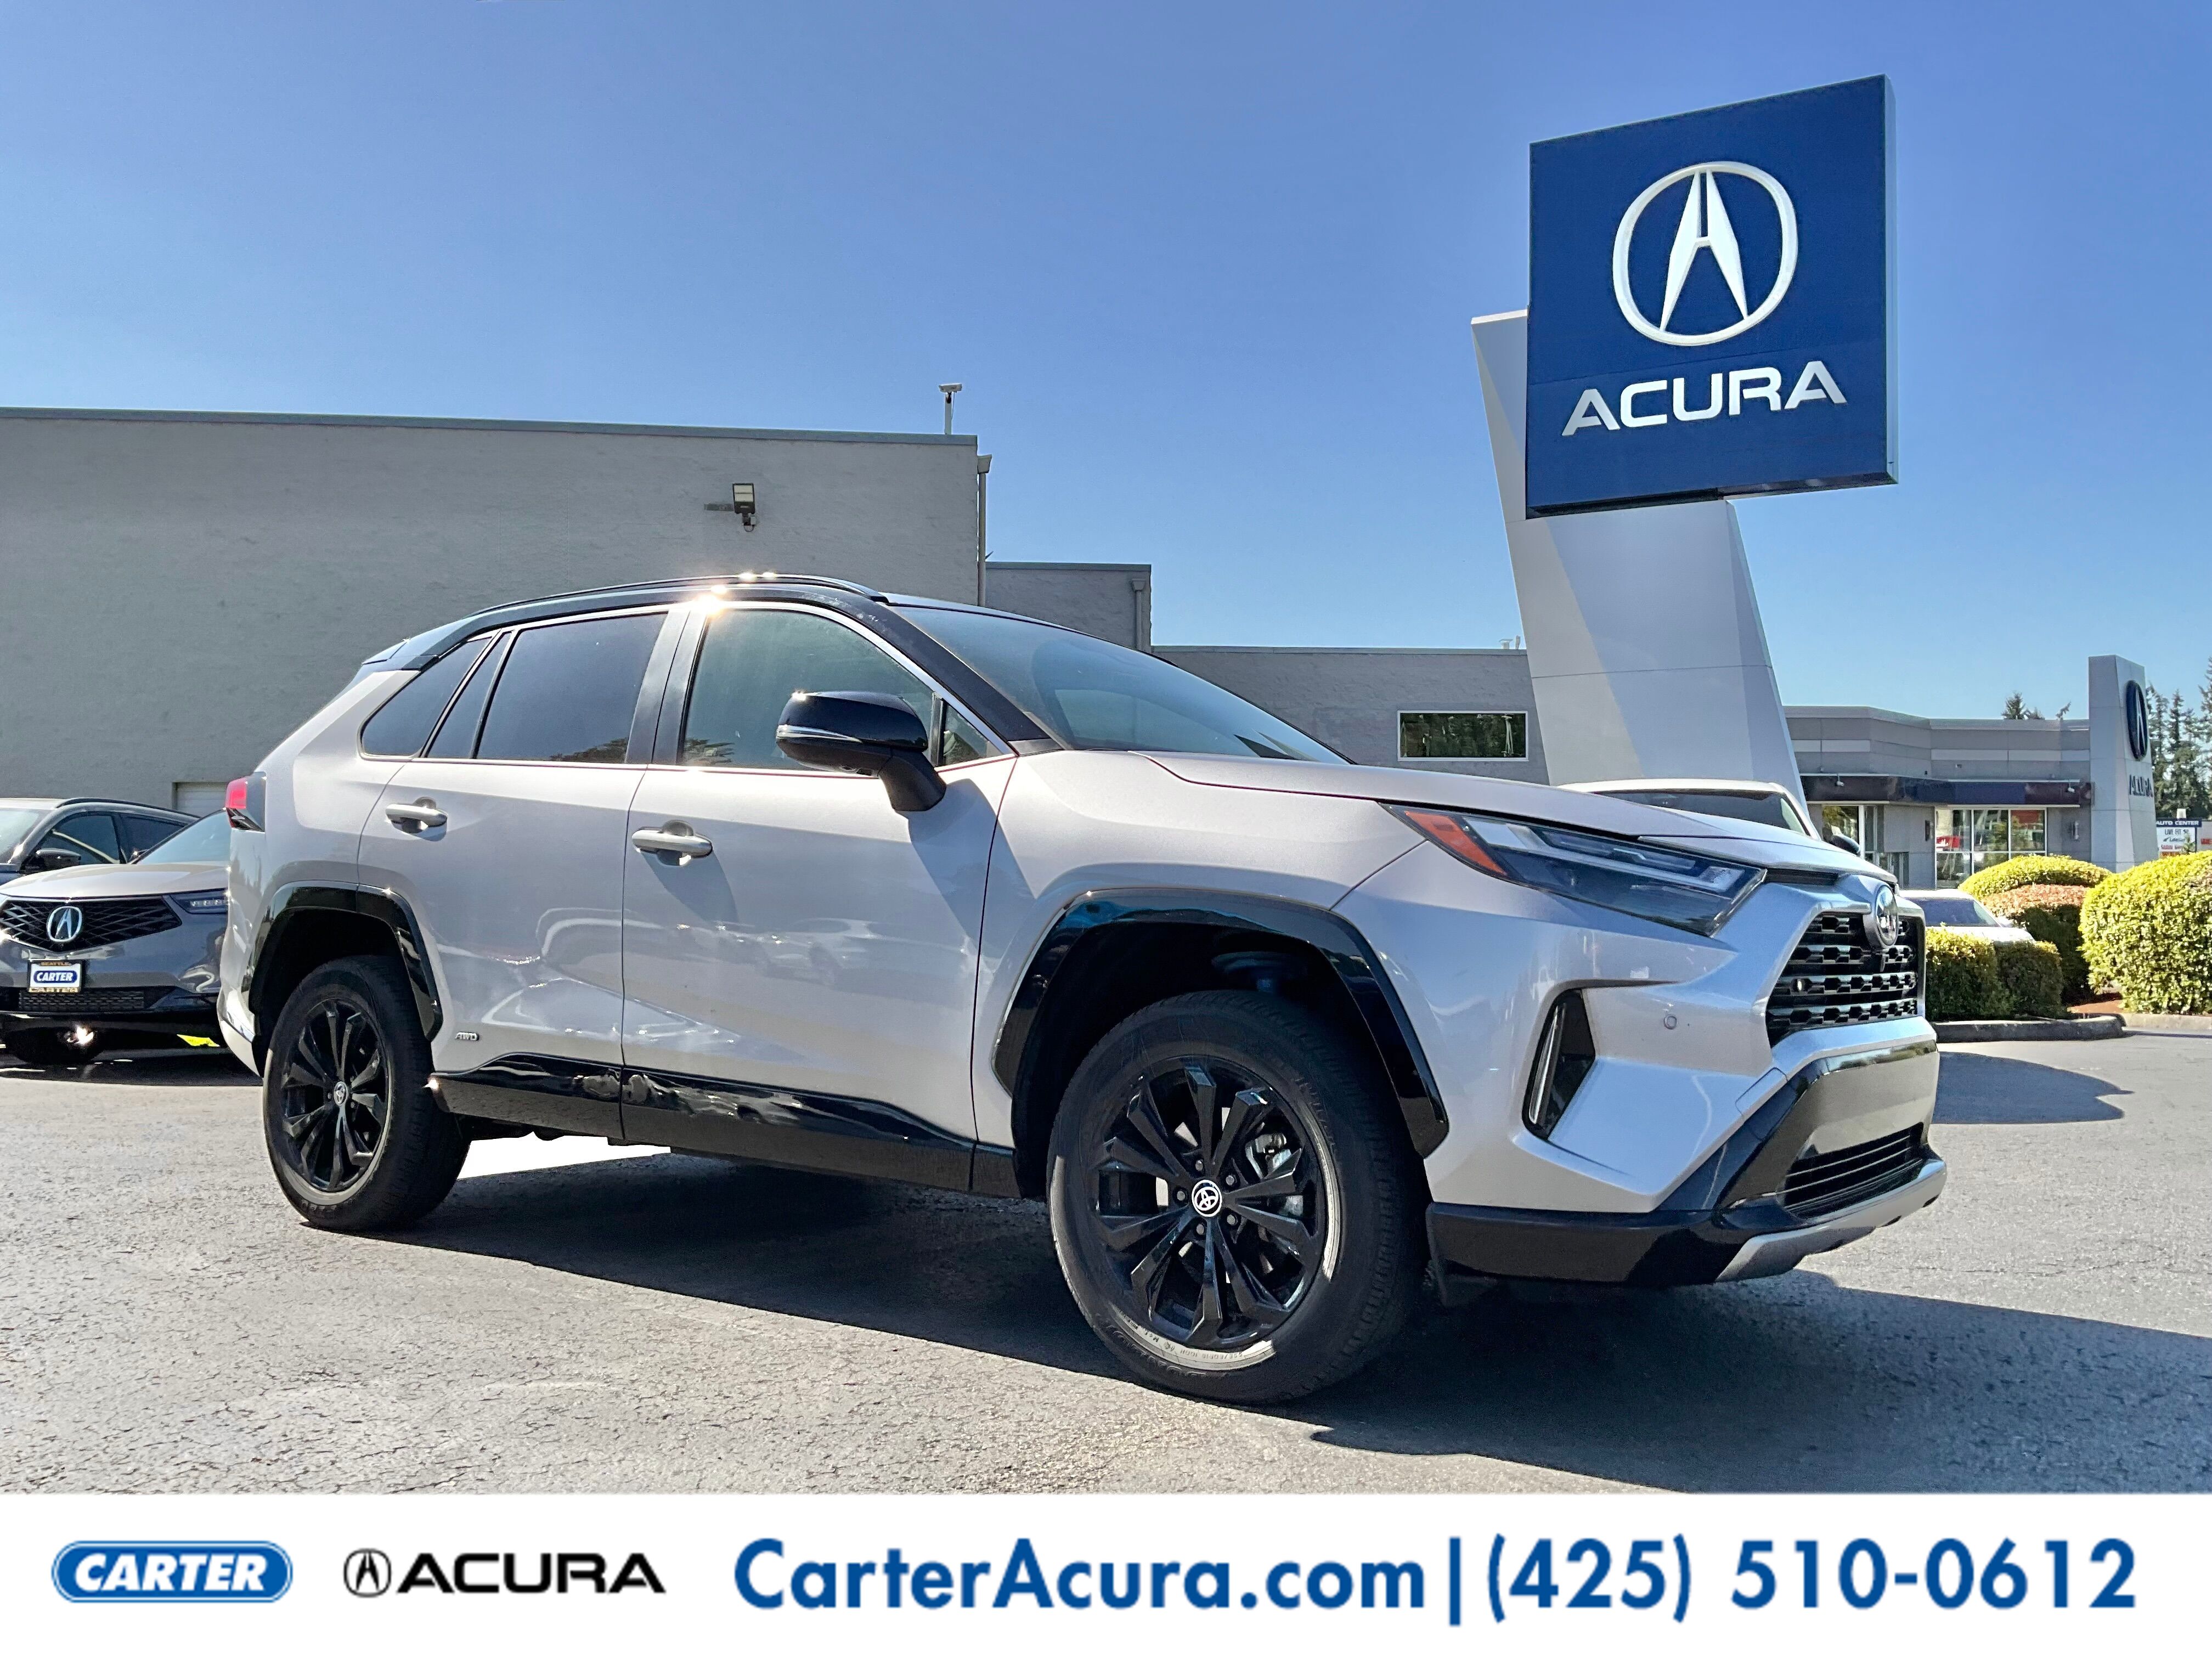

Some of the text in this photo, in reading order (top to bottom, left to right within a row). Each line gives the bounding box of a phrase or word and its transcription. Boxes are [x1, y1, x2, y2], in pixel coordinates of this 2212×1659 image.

[1562, 360, 1847, 436] ACURA
[36, 972, 73, 981] CARTER
[455, 1031, 479, 1041] AWD
